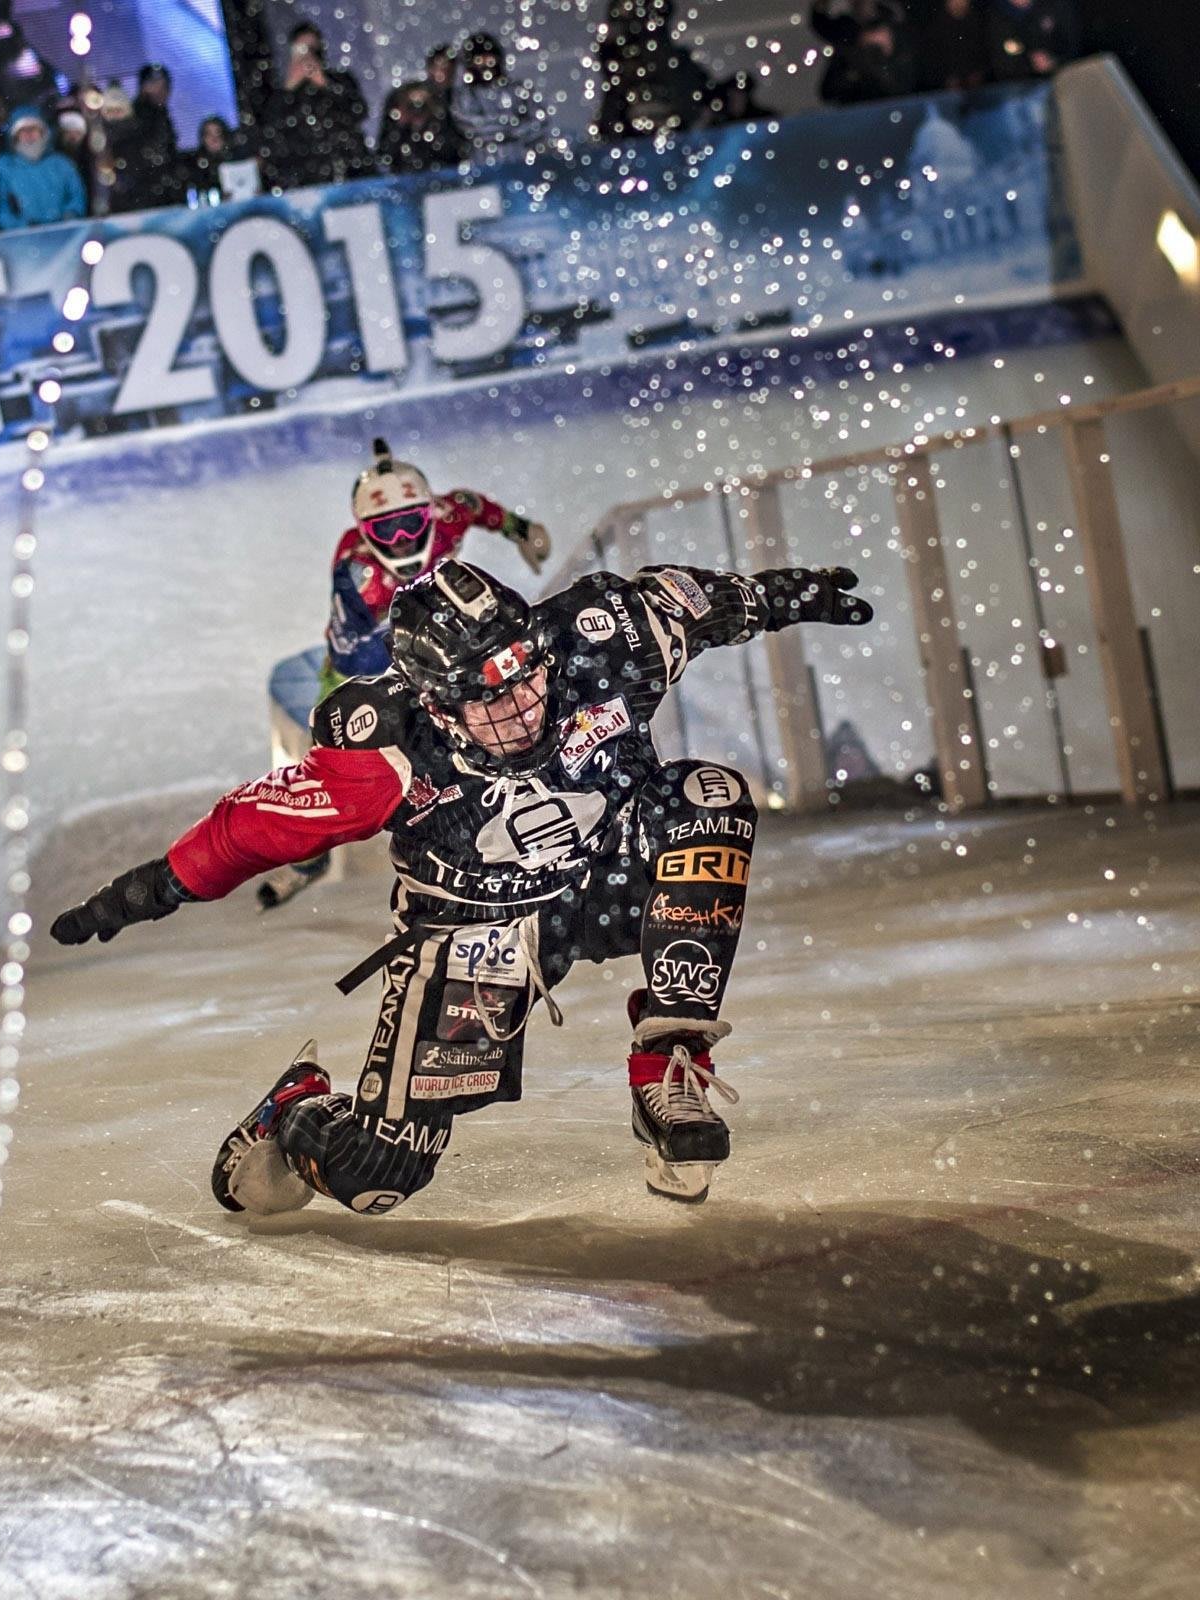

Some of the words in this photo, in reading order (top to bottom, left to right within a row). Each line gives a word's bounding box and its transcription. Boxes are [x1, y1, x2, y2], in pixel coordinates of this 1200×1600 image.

[90, 184, 526, 415] 2015
[611, 595, 641, 651] TEAMLTD
[350, 711, 374, 737] LTD
[563, 732, 596, 758] Red
[593, 712, 625, 740] Bull
[667, 816, 753, 844] TEAMLTD
[662, 851, 750, 881] GRIT
[651, 958, 722, 999] SWS
[414, 1077, 450, 1092] WORLD
[451, 1075, 465, 1090] ICE
[466, 1073, 497, 1087] CROSS
